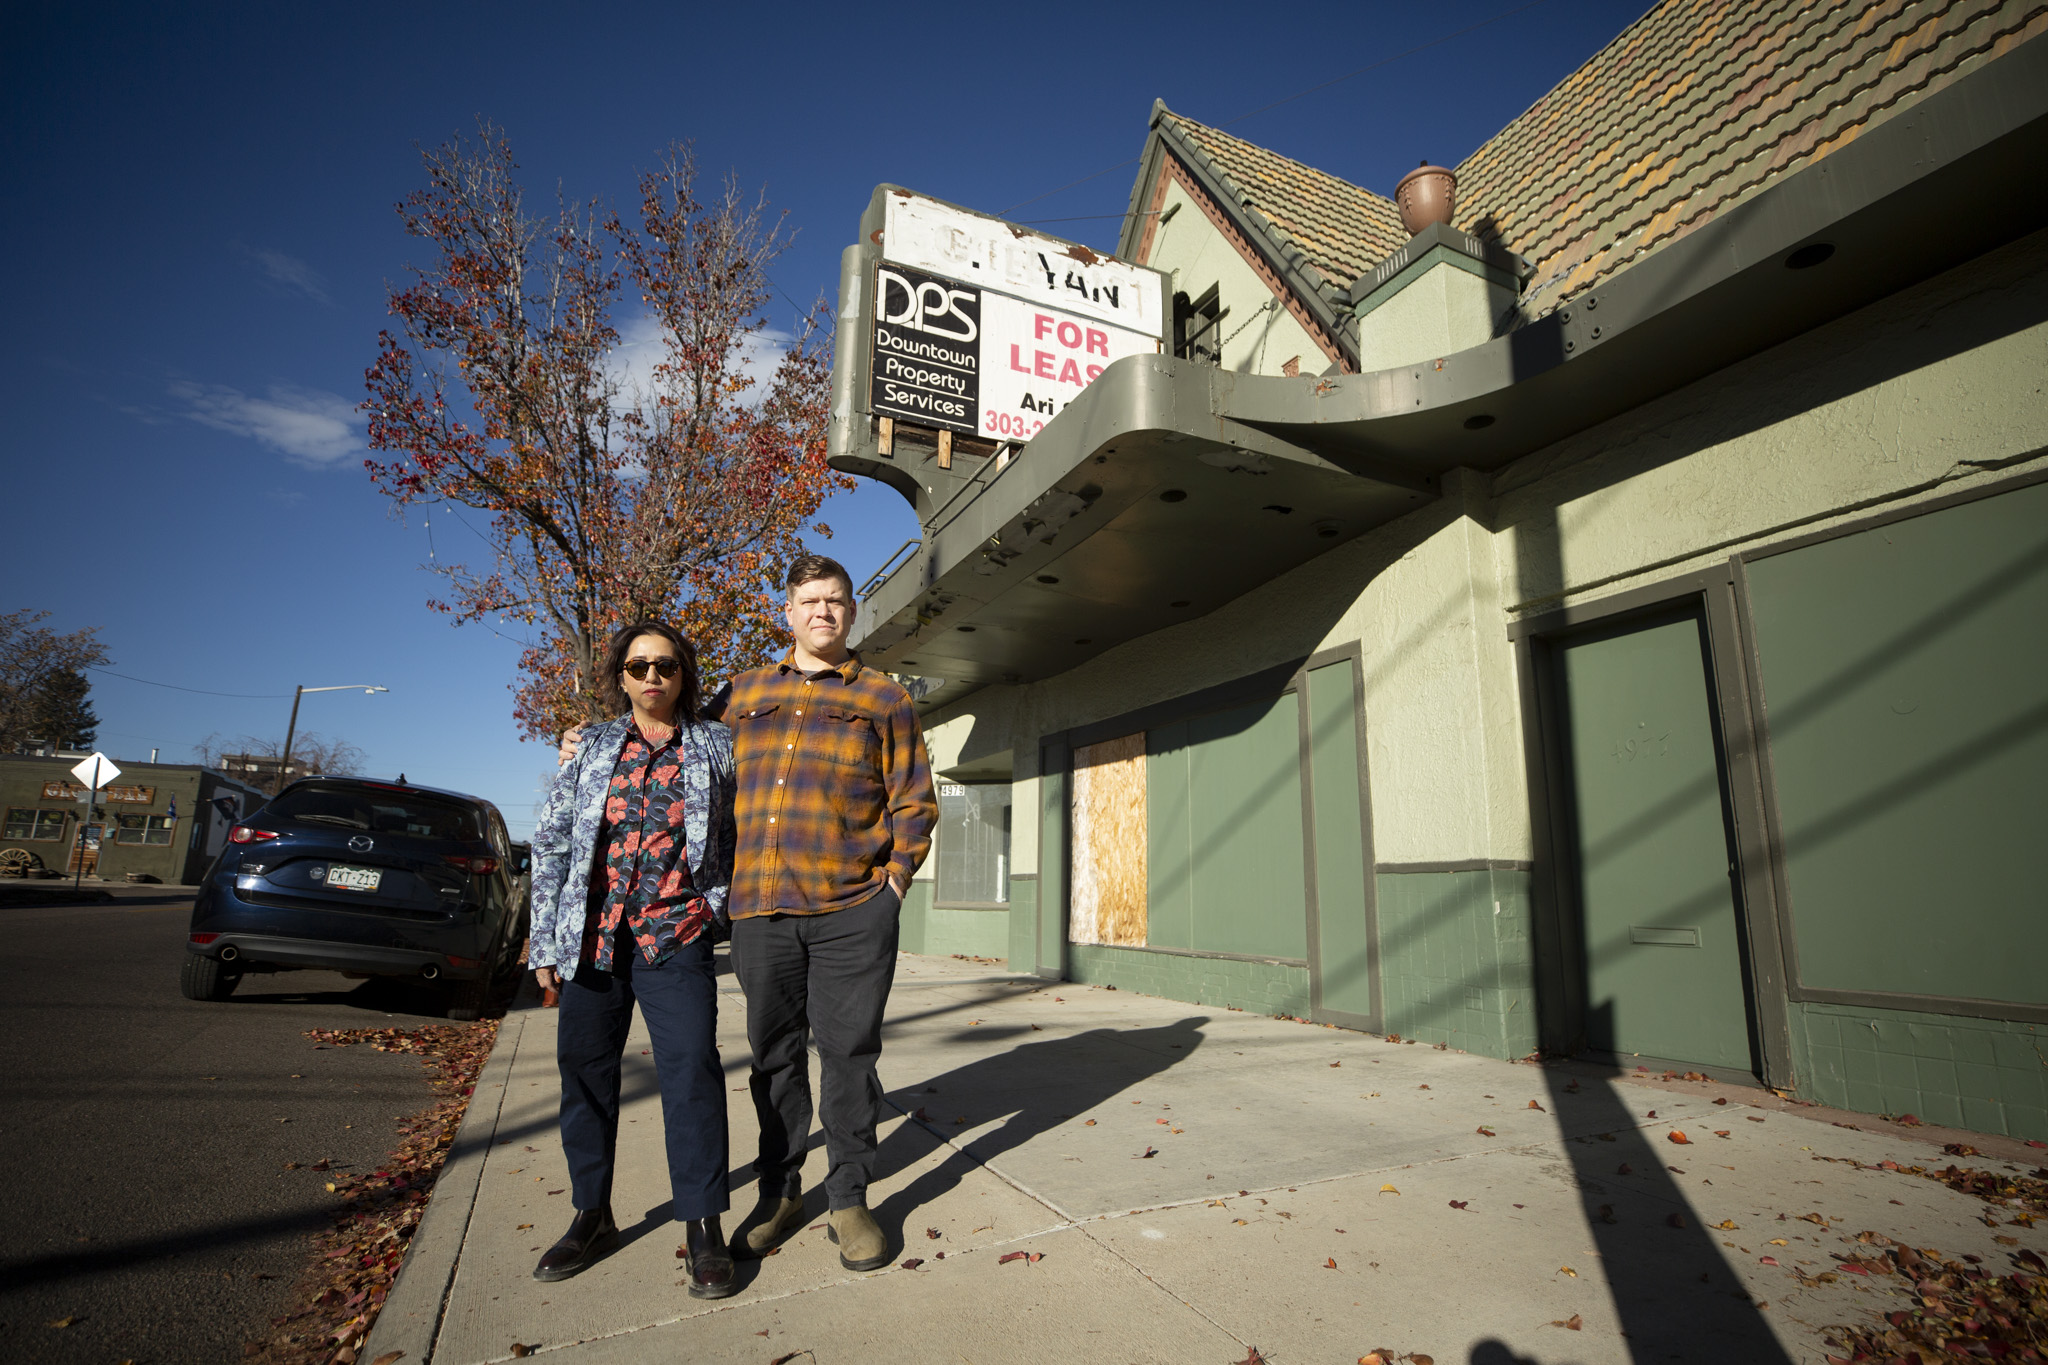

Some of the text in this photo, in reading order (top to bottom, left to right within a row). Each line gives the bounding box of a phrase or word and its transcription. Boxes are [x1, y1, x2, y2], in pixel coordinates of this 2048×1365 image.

[876, 268, 978, 343] DPS
[877, 328, 976, 369] Downtown
[1034, 312, 1109, 358] FOR
[885, 357, 966, 395] Property
[1010, 343, 1105, 387] LEAS
[884, 383, 965, 417] Services
[1020, 392, 1054, 416] Ari
[985, 409, 1048, 438] 303-2
[942, 785, 964, 796] 4979
